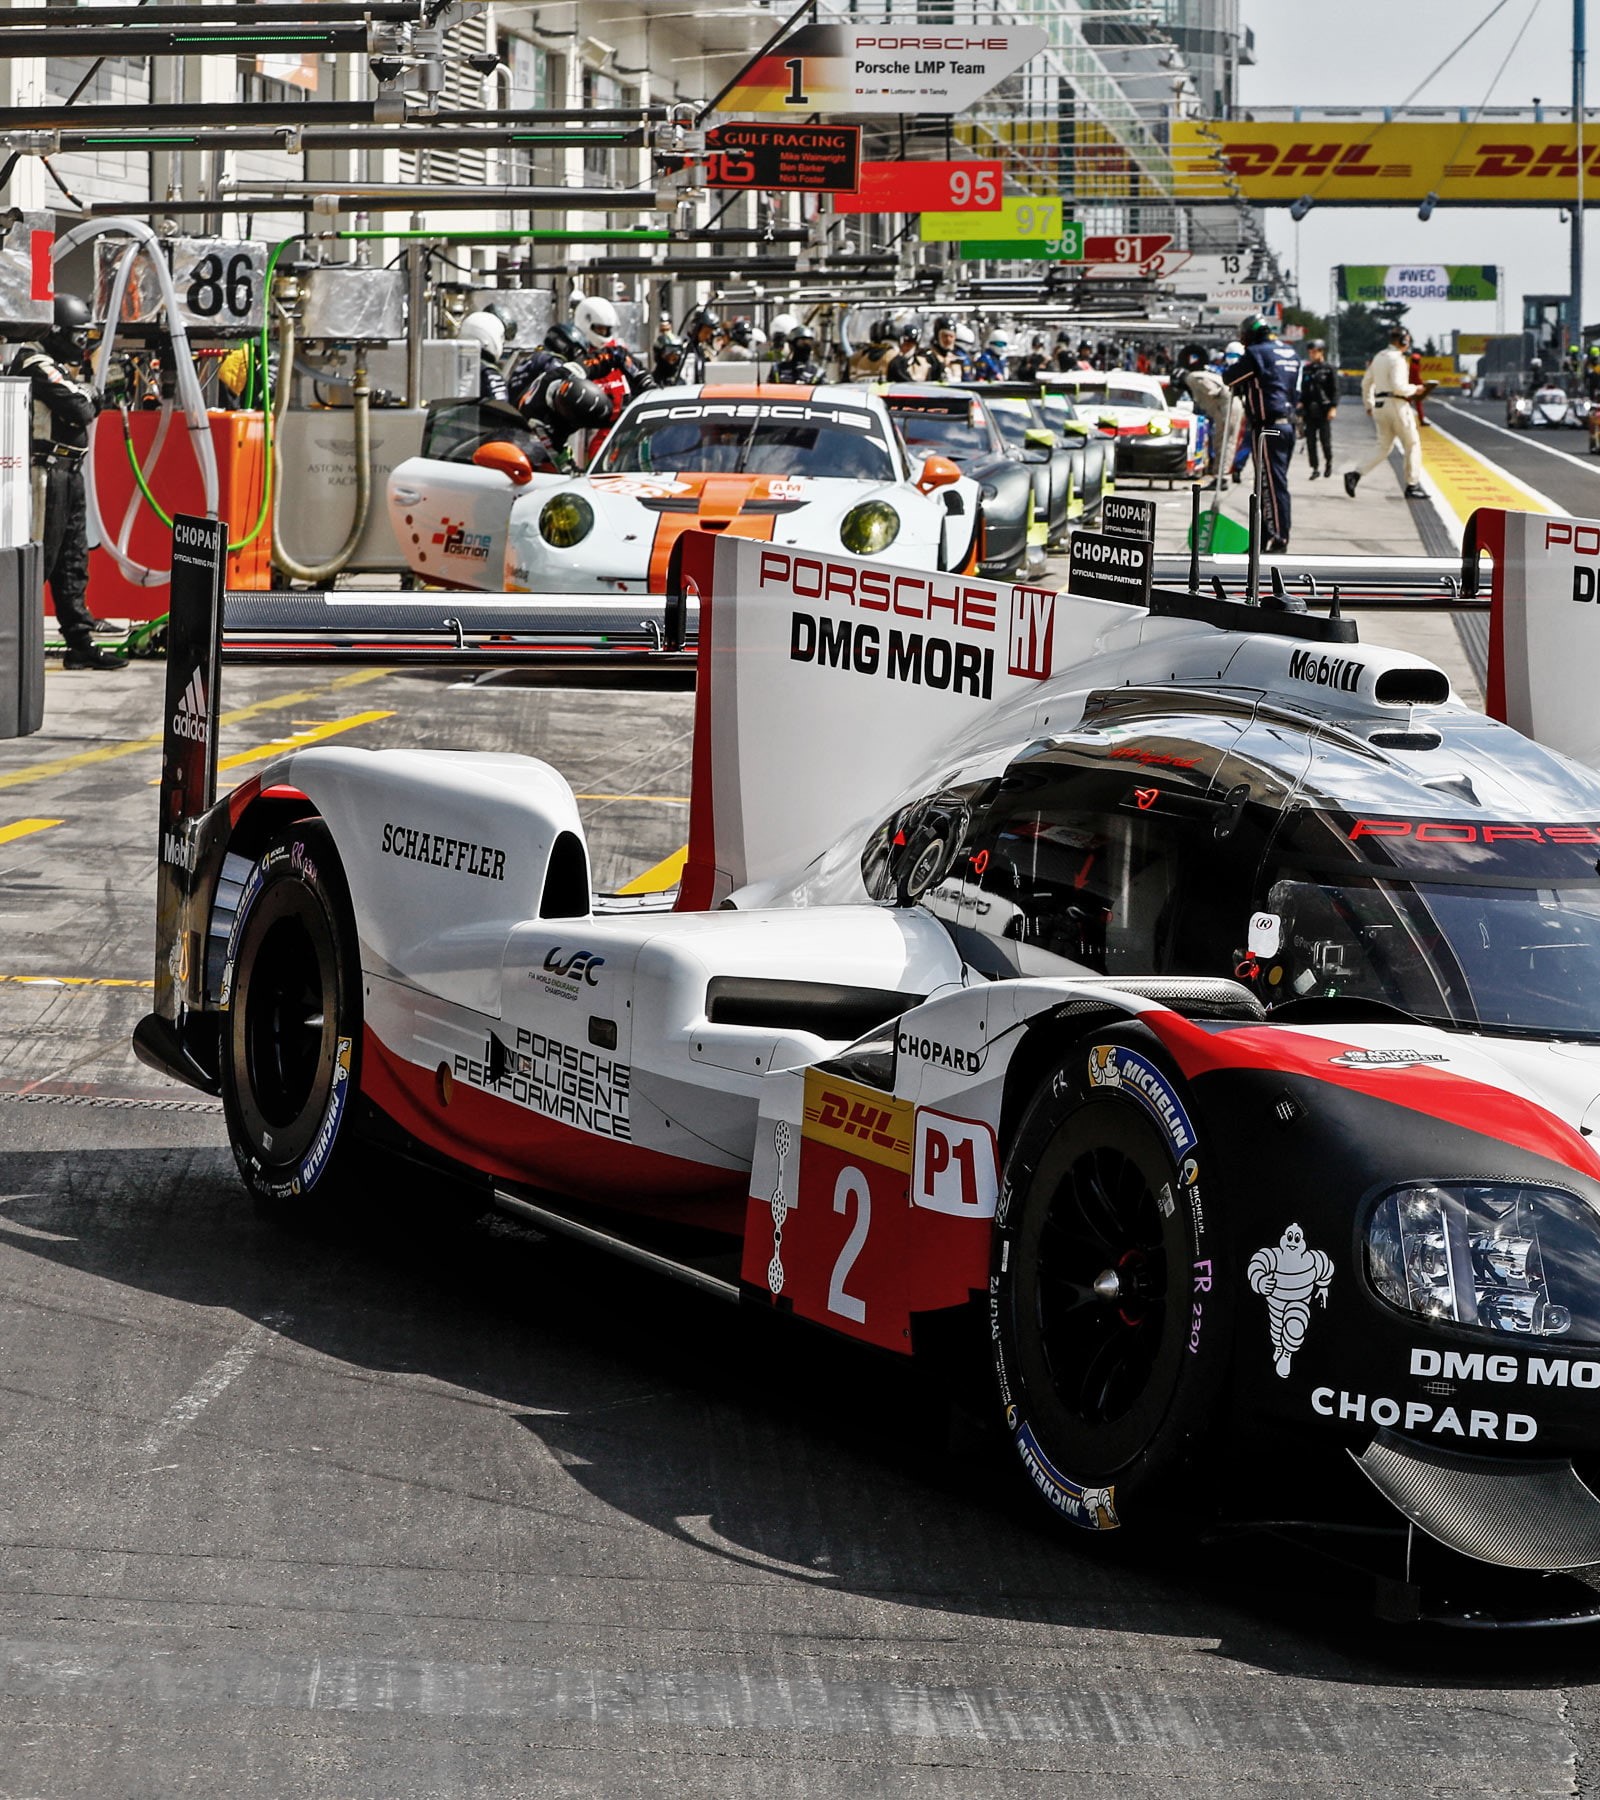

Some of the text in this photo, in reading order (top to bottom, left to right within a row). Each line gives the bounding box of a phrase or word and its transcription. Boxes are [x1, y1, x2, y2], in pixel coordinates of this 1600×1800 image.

[855, 37, 1009, 50] PORSCHE
[785, 58, 808, 104] 1
[855, 60, 986, 75] Porsche LMP Team
[929, 87, 948, 97] Tandy
[723, 132, 847, 149] GULF RACING
[779, 162, 797, 172] Ben
[1219, 143, 1383, 177] DHL
[779, 174, 797, 183] Nick
[949, 170, 997, 206] 95
[1016, 204, 1056, 235] 97
[1114, 238, 1143, 263] 91
[1221, 255, 1240, 274] 13
[186, 252, 254, 318] 86
[1398, 269, 1437, 282] #WEC
[1254, 286, 1266, 301] 8
[635, 404, 872, 430] PORSCHE
[308, 464, 392, 475] ASTON MTIN
[772, 483, 803, 493] AM
[1073, 541, 1144, 568] CHOPARD
[759, 550, 998, 632] PORSCHE
[1071, 568, 1143, 587] OFFICIAL TIMING PARTNER
[1011, 588, 1053, 678] HY
[790, 611, 995, 701] DMG MORI
[1289, 648, 1366, 693] Mobil 1
[172, 710, 211, 744] adidas
[381, 823, 506, 881] SCHAEFFLER
[543, 946, 606, 987] WEC
[551, 978, 580, 995] ENDURANCE
[516, 1027, 631, 1090] PORSCHE
[898, 1032, 981, 1073] CHOPARD
[819, 1092, 897, 1151] DHL
[1121, 1059, 1190, 1150] MICHELIN
[302, 1091, 340, 1185] MICHELIN
[923, 1126, 979, 1205] P1
[1193, 1184, 1205, 1234] MICHELIN
[827, 1164, 872, 1325] 2
[1192, 1259, 1213, 1294] FR
[1409, 1348, 1518, 1385] DMG
[1310, 1386, 1539, 1443] CHOPARD
[1016, 1437, 1081, 1522] MICHELIN
